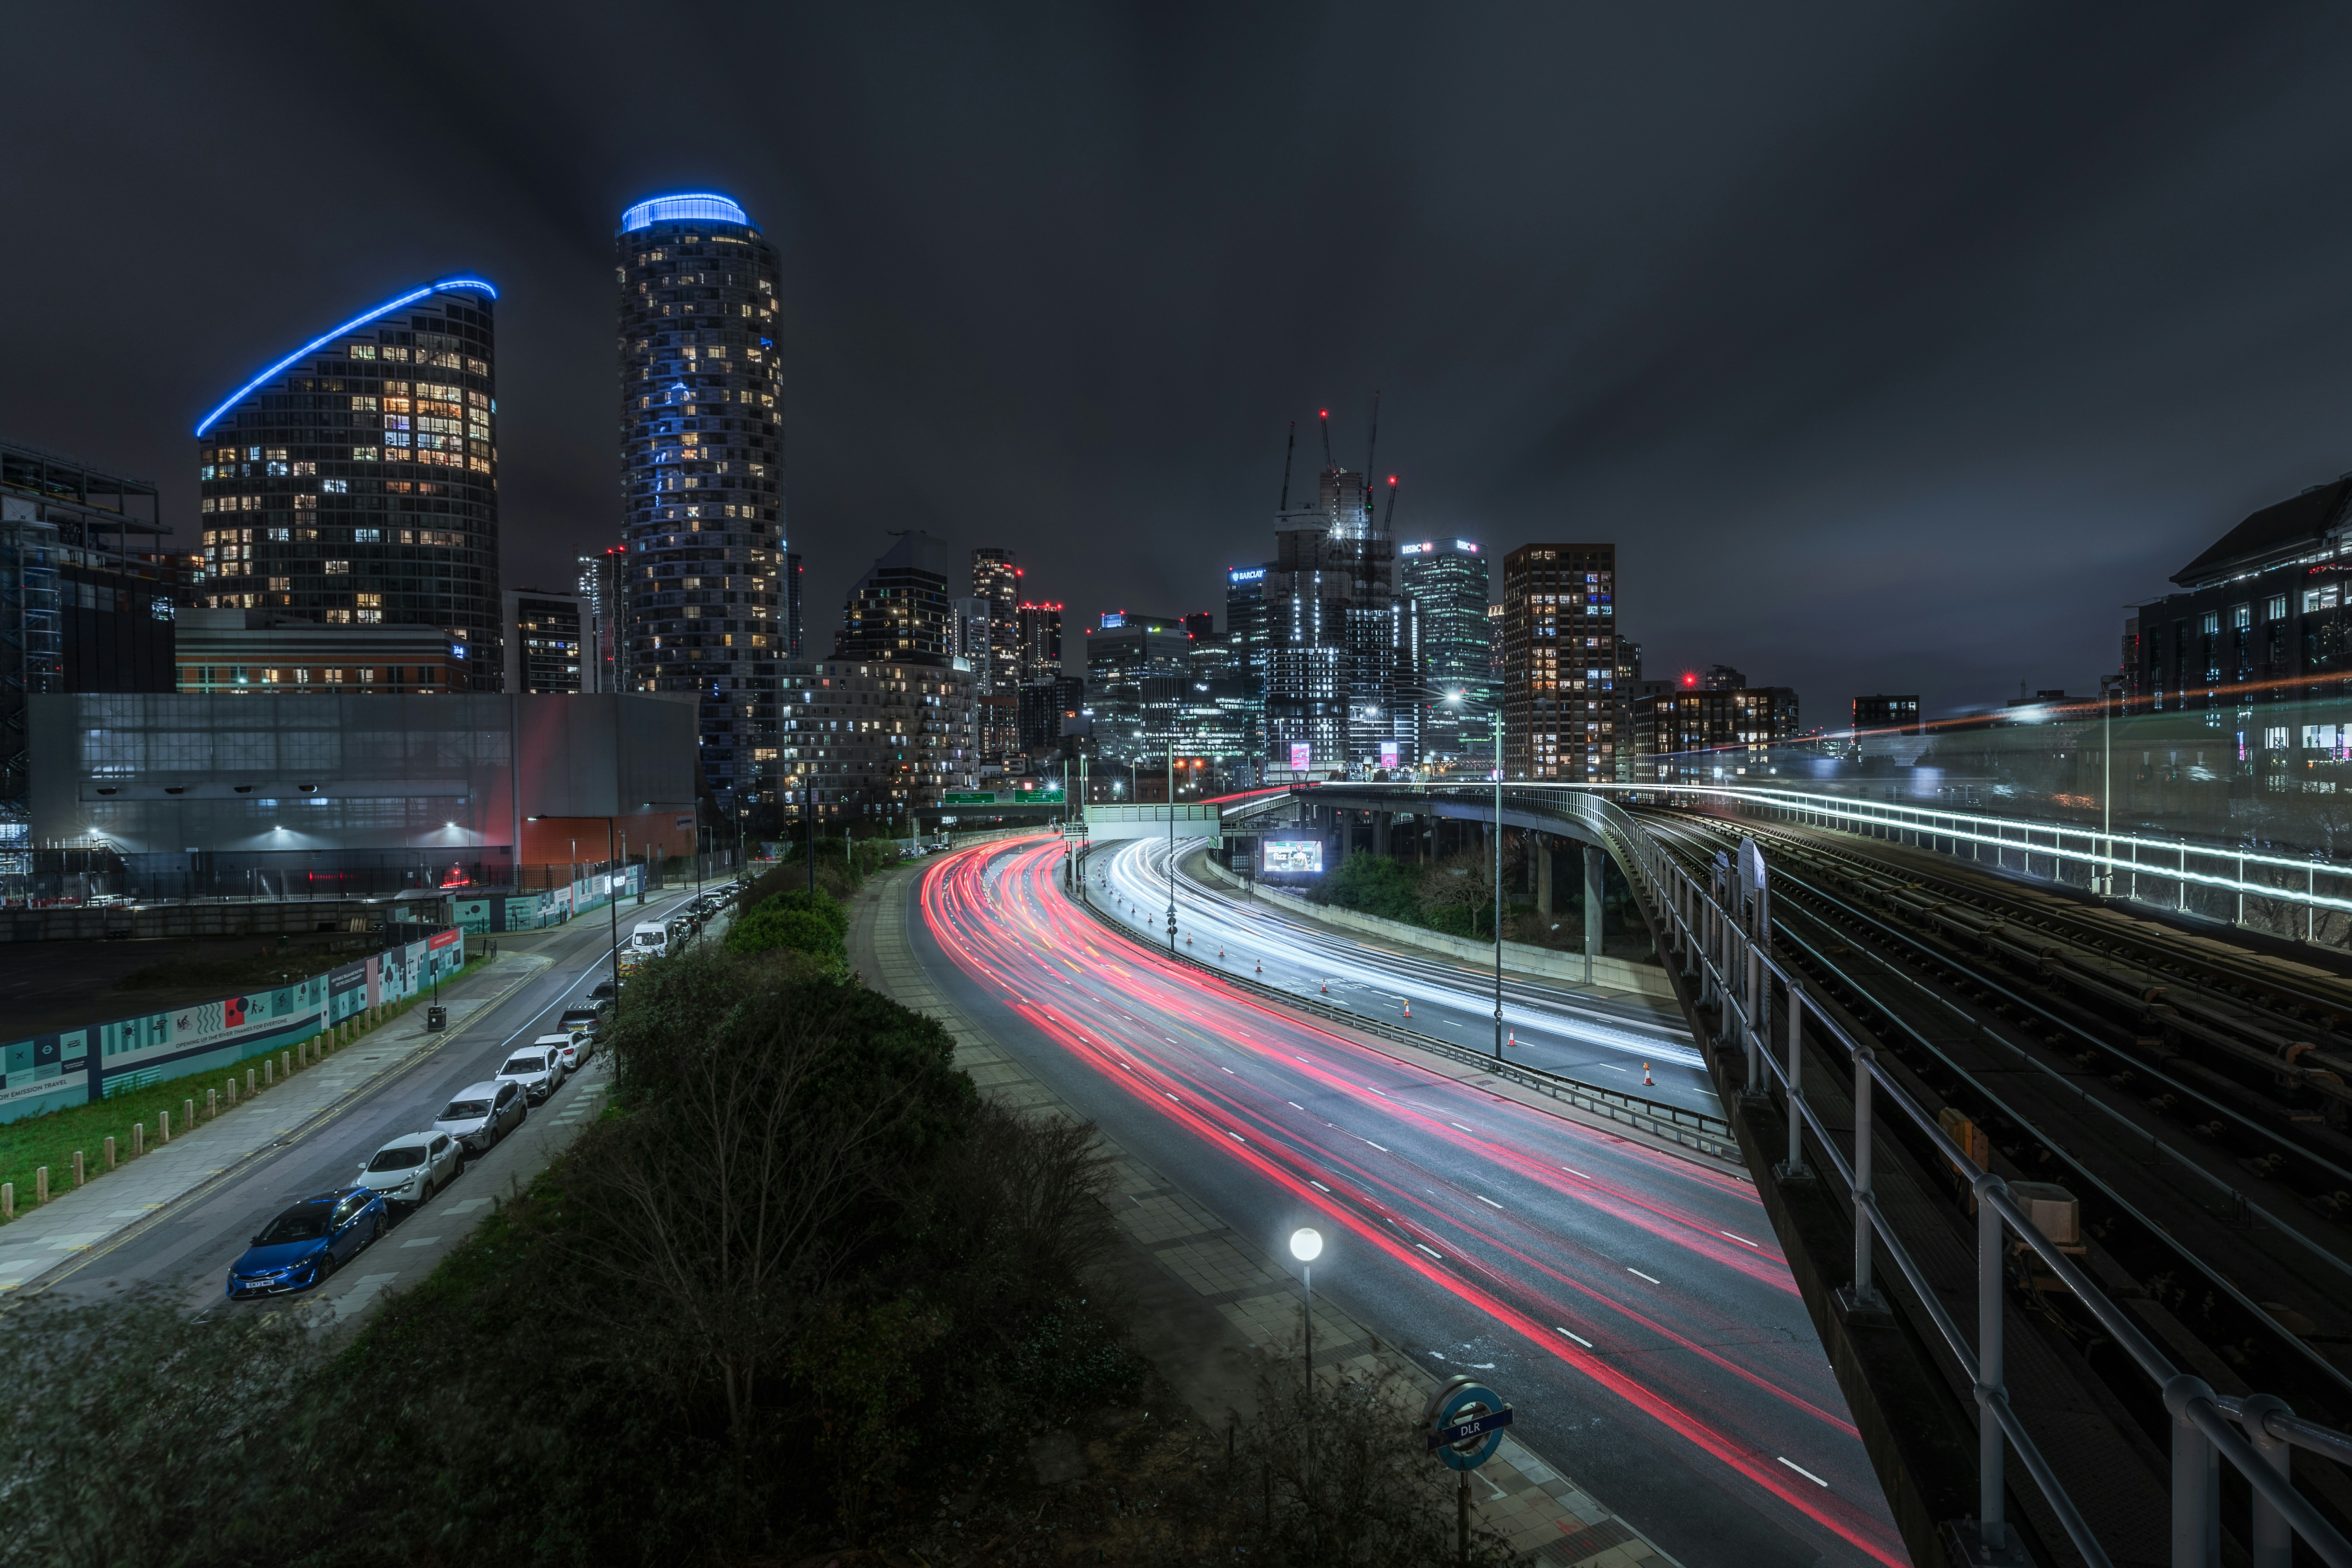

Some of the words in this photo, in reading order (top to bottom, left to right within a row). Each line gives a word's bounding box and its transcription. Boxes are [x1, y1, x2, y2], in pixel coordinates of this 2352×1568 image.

[1402, 544, 1422, 554] HSBC
[1457, 540, 1470, 550] HSBC
[1239, 570, 1266, 579] BARCLAY
[613, 876, 626, 887] ADLEY
[176, 1038, 200, 1048] OPENING
[234, 1026, 252, 1035] THAMES
[263, 1018, 287, 1028] EVERYONE
[11, 1085, 42, 1098] EMISSION
[44, 1079, 67, 1089] TRAVEL
[1461, 1422, 1480, 1437] DLR
